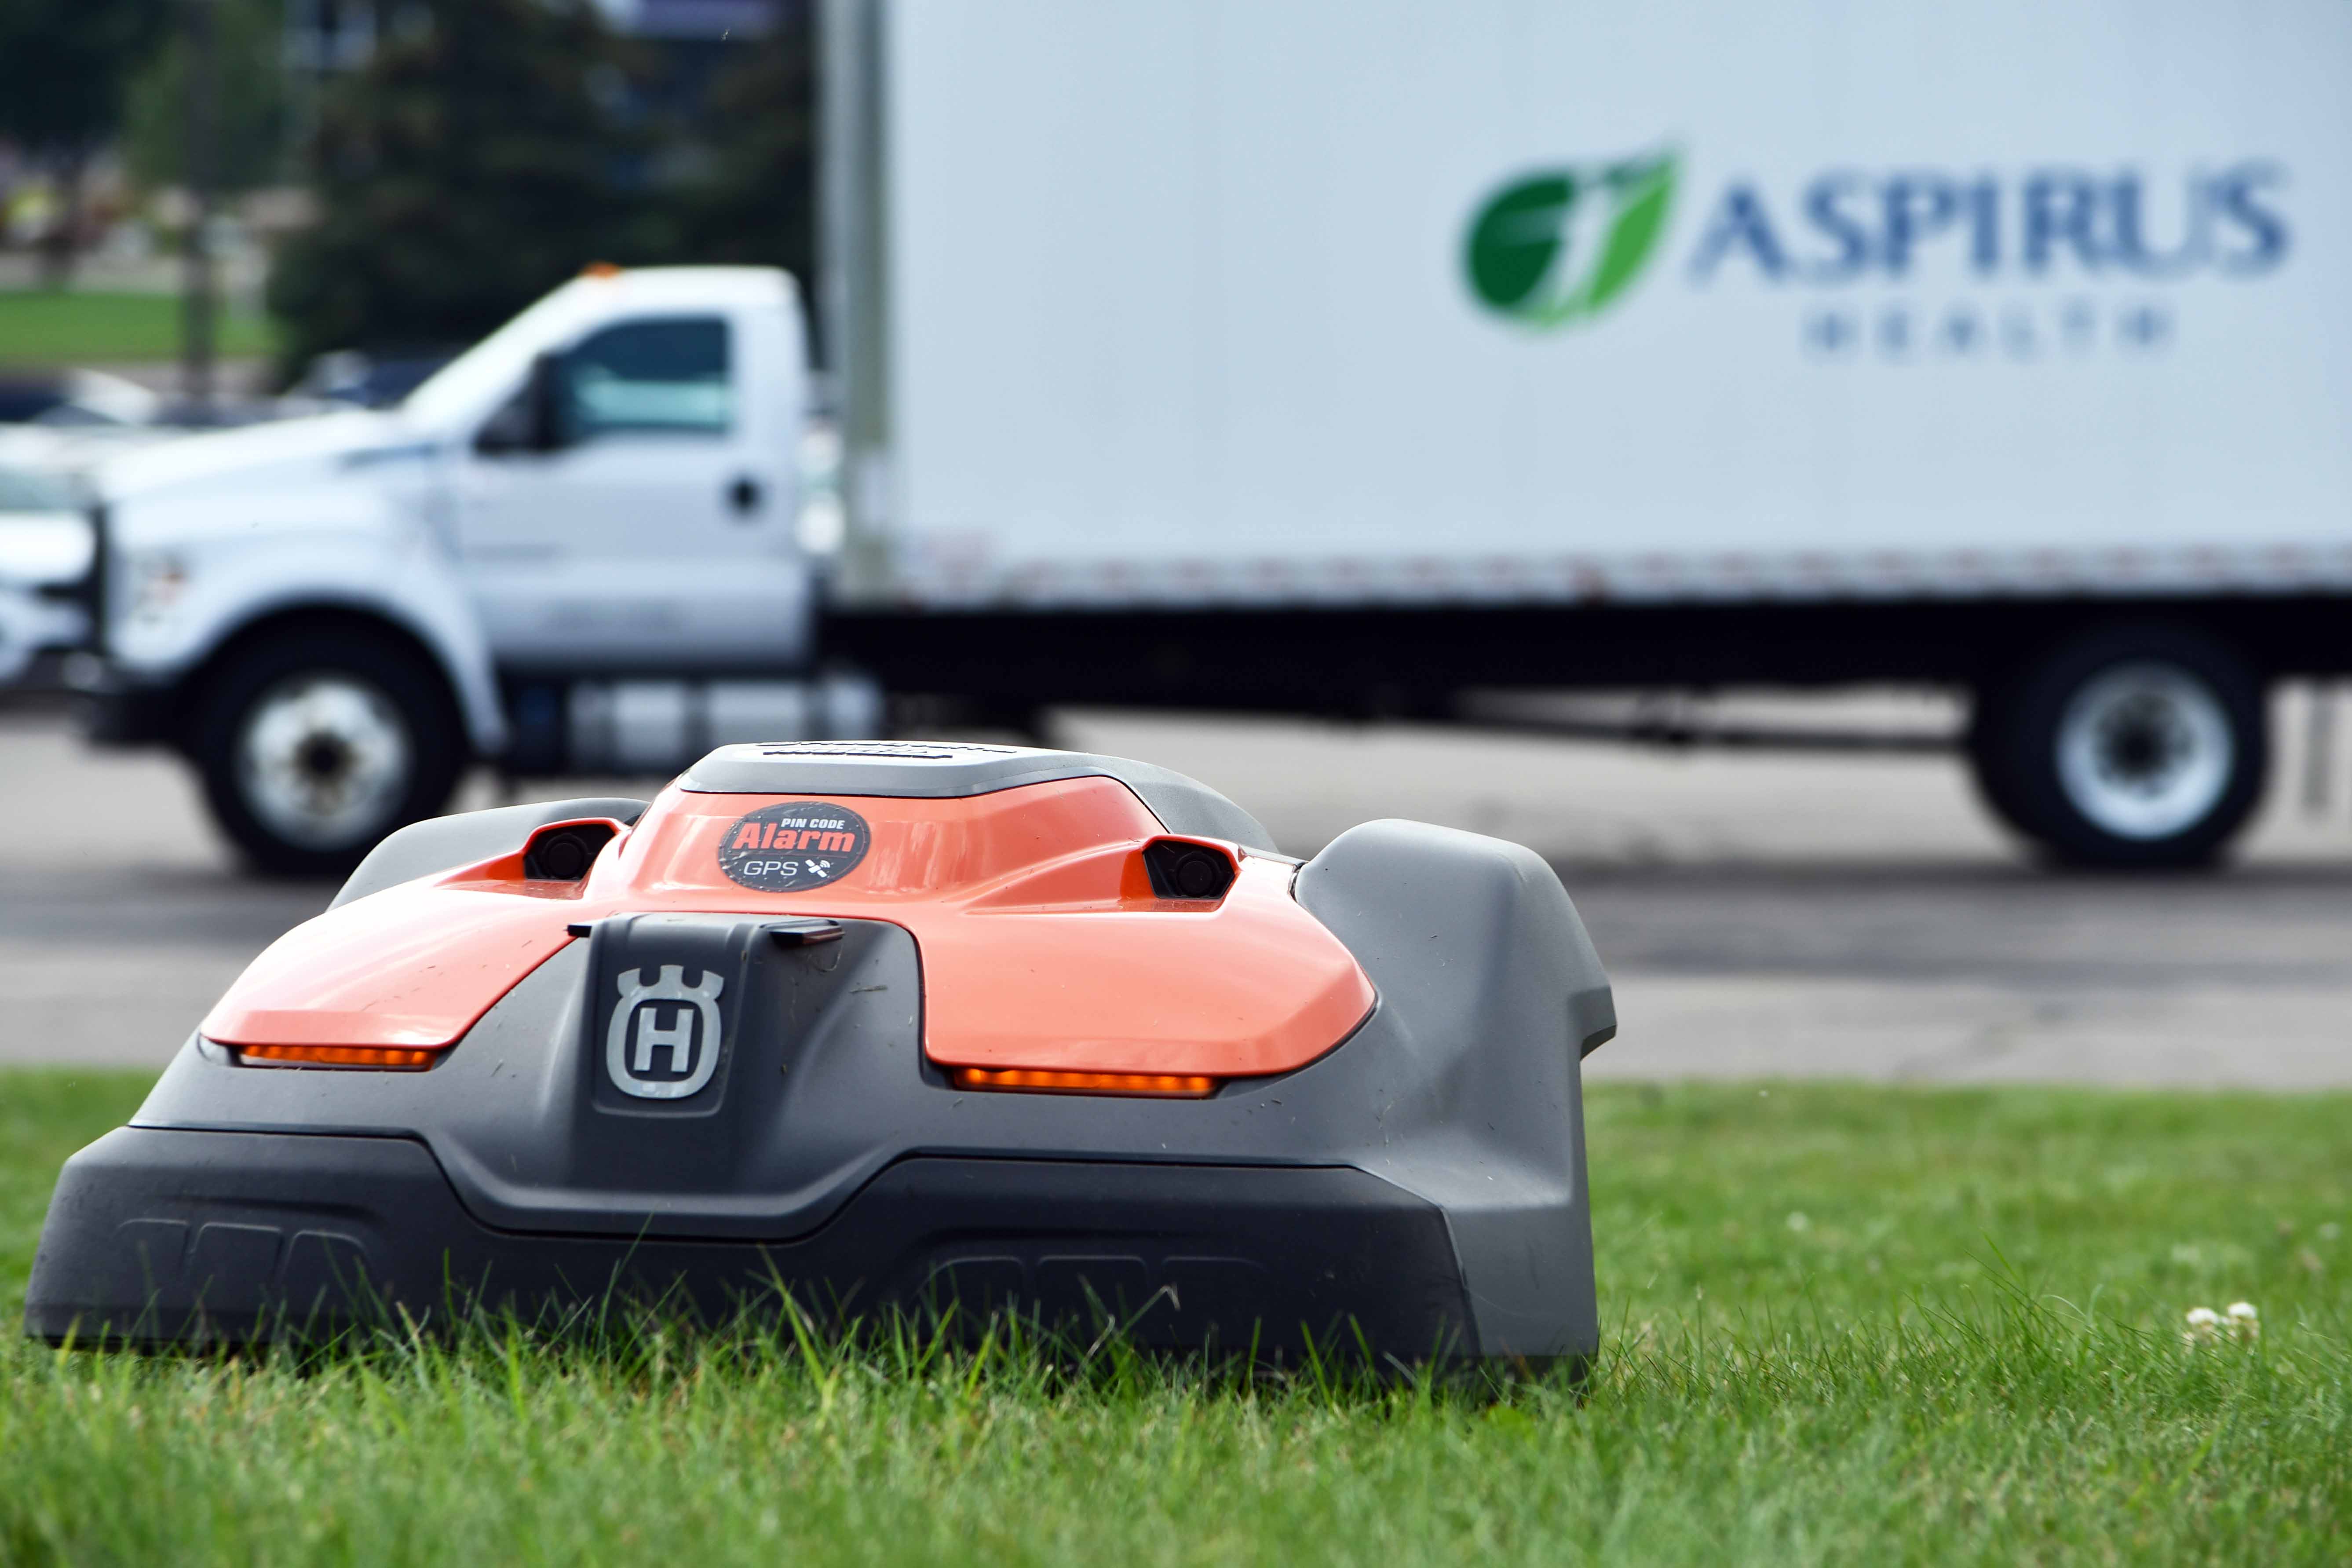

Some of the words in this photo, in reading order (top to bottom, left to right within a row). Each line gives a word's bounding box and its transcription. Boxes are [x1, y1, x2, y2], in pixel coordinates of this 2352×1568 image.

[1688, 159, 2292, 285] ASPIRUS
[1802, 300, 2173, 362] HEALTH
[732, 823, 855, 852] Alarm
[781, 818, 806, 828] PIN
[809, 818, 844, 830] CODE
[743, 861, 798, 876] GPS
[633, 1007, 694, 1072] H
